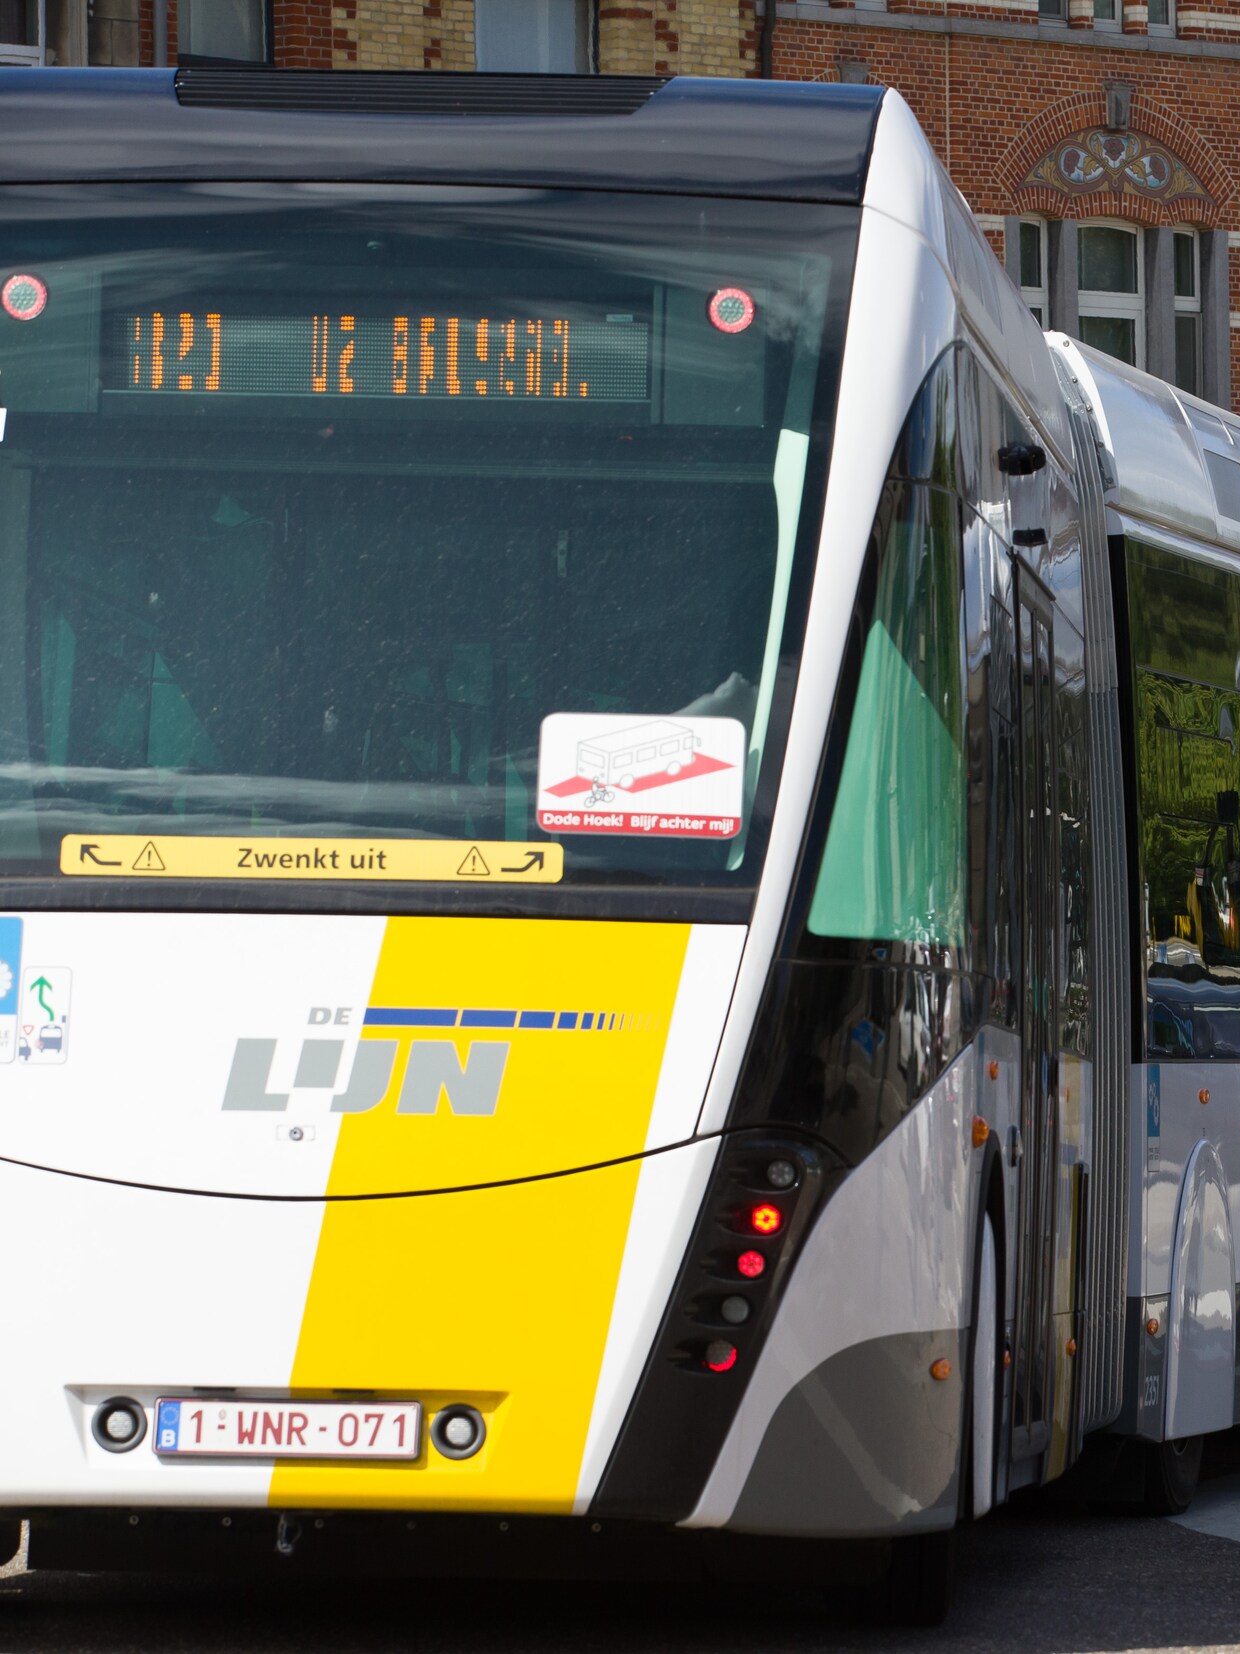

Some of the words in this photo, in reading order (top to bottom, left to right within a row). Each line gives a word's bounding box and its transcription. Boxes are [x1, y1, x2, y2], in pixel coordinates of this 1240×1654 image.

[543, 813, 580, 826] Dode
[583, 814, 624, 827] Hoek!
[630, 815, 660, 831] Blijf
[659, 816, 707, 830] achter
[709, 819, 734, 834] mij!
[237, 847, 339, 870] Zwenkt
[350, 849, 388, 871] uit
[307, 1006, 353, 1026] DE
[220, 1037, 511, 1116] LIJN
[1144, 1375, 1160, 1407] 2351
[160, 1428, 176, 1448] B
[190, 1409, 407, 1449] 1-WNR-071
